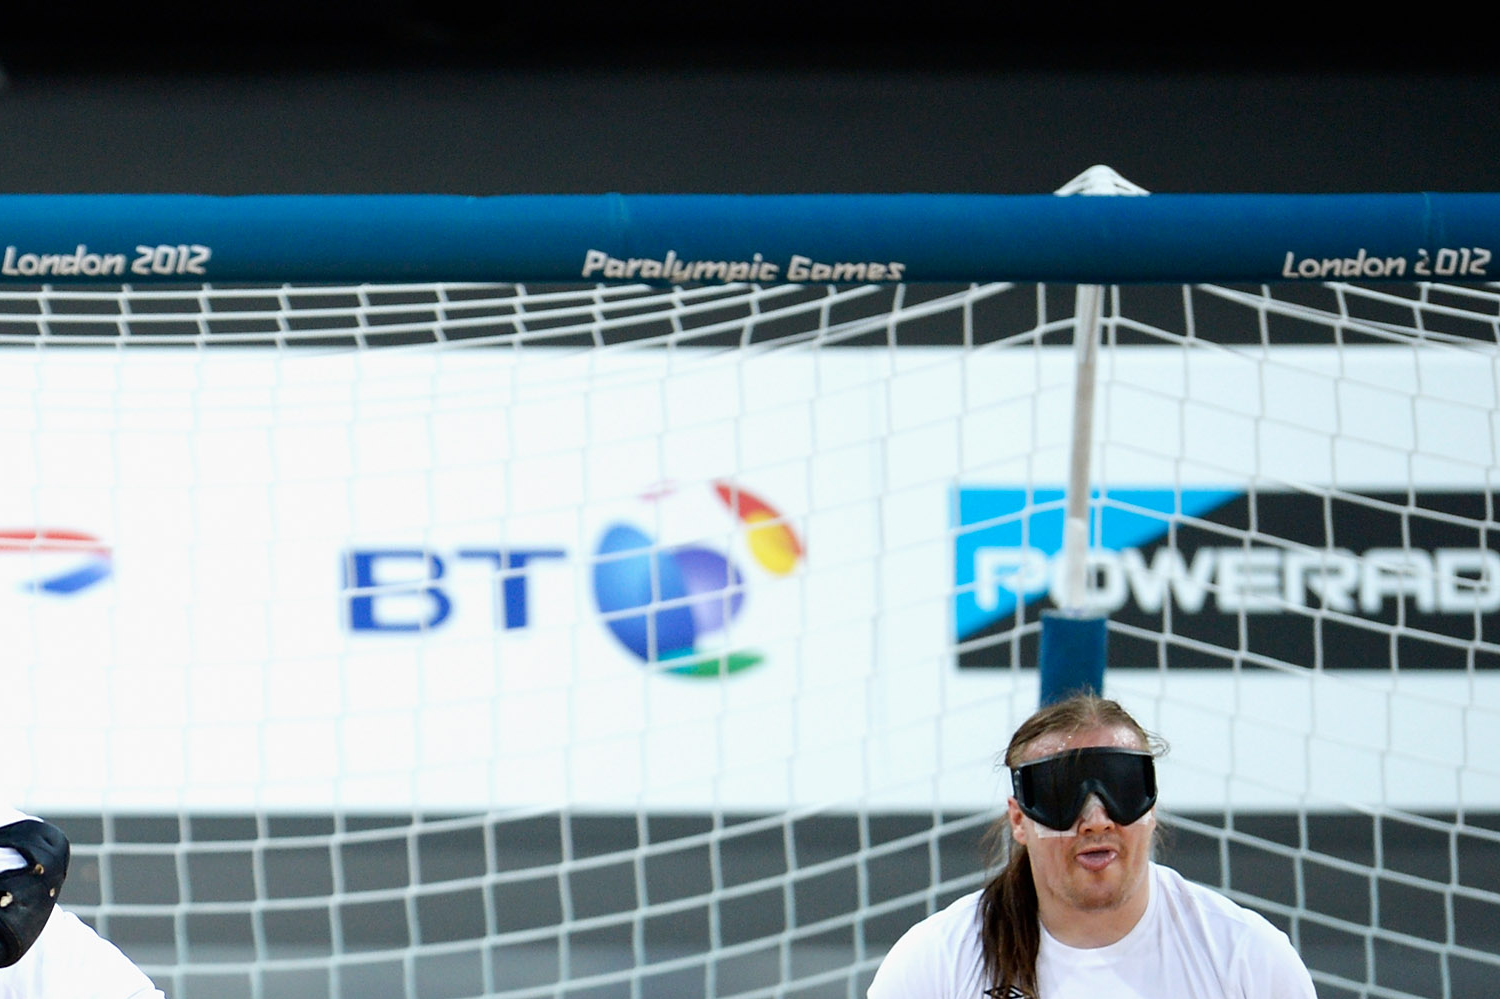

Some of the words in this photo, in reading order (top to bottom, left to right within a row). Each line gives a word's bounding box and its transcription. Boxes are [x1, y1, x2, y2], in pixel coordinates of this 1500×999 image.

[2, 245, 124, 276] London
[131, 245, 211, 274] 2012
[581, 249, 780, 283] Paralympic
[787, 254, 906, 282] Games
[1282, 248, 1406, 278] London
[1414, 247, 1492, 276] 2012
[344, 548, 567, 633] BT
